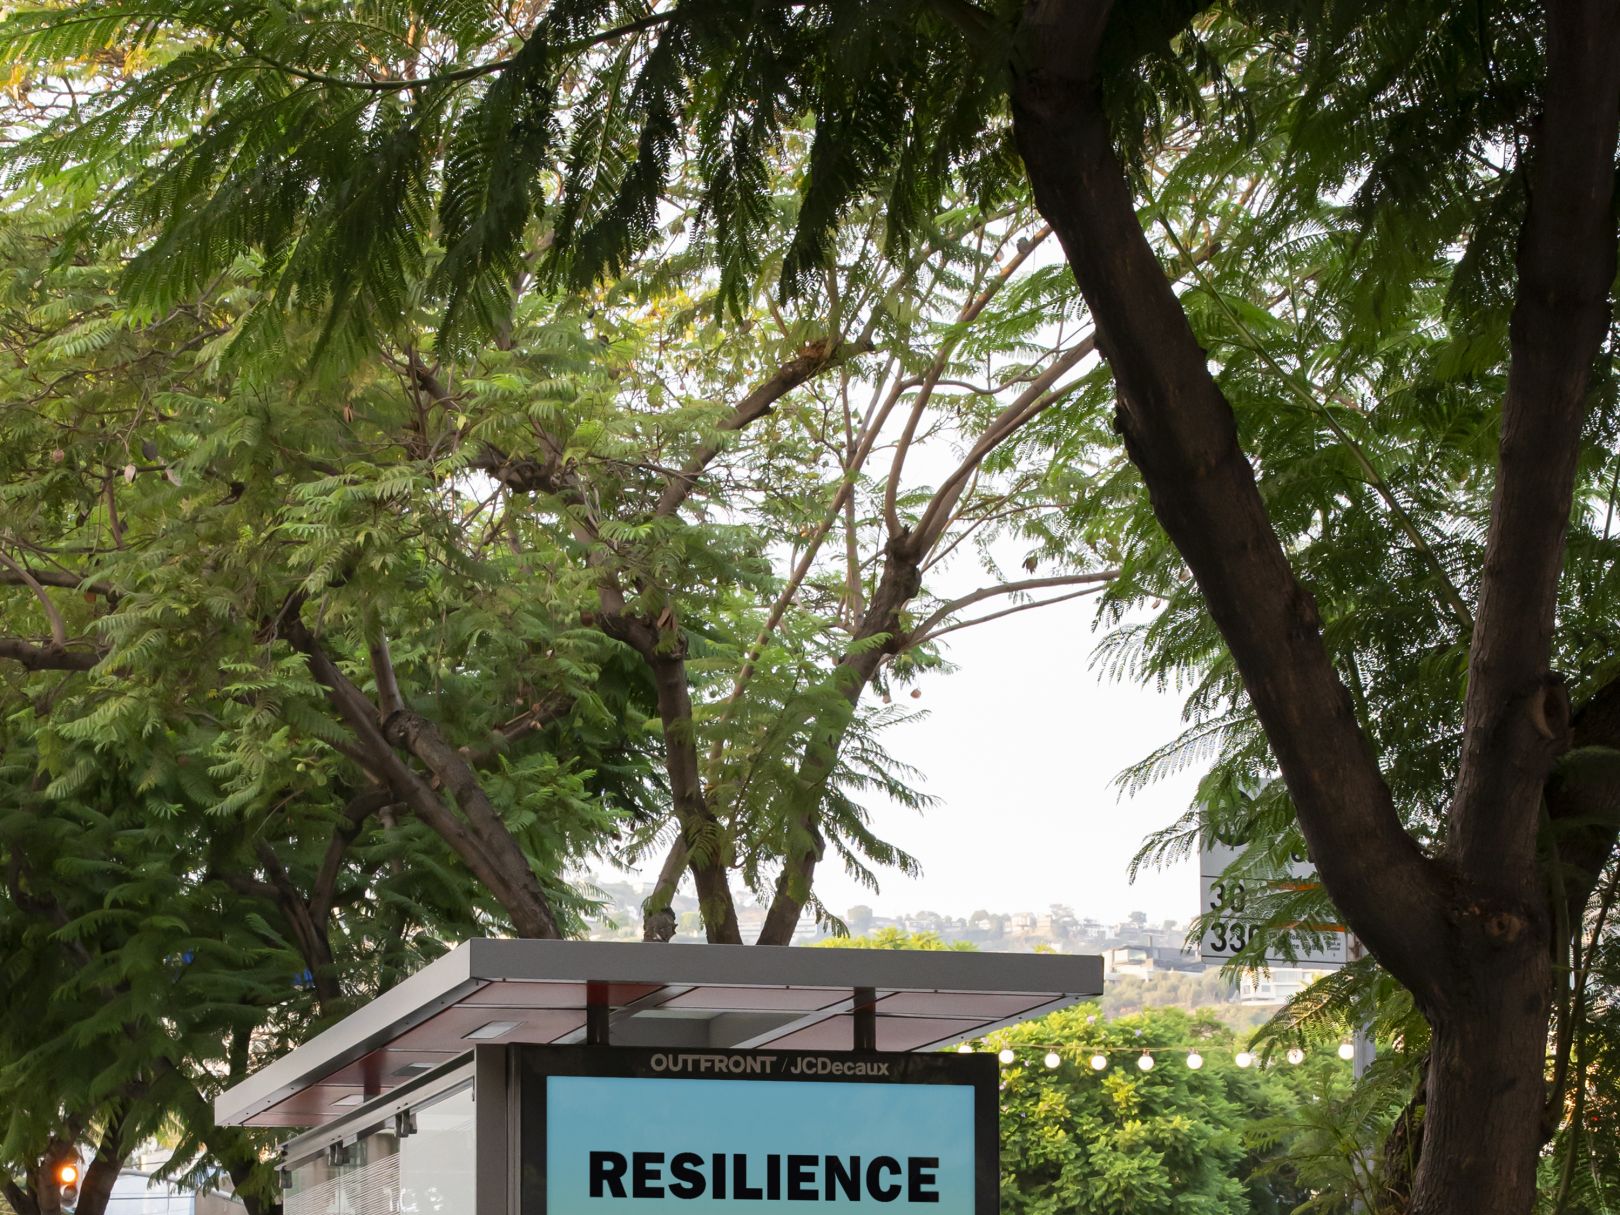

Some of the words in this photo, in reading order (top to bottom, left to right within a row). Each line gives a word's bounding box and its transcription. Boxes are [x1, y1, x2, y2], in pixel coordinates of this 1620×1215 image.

[650, 1053, 777, 1073] OUTFRONT
[791, 1057, 889, 1075] JCDecaux
[589, 1150, 940, 1203] RESILIENCE
